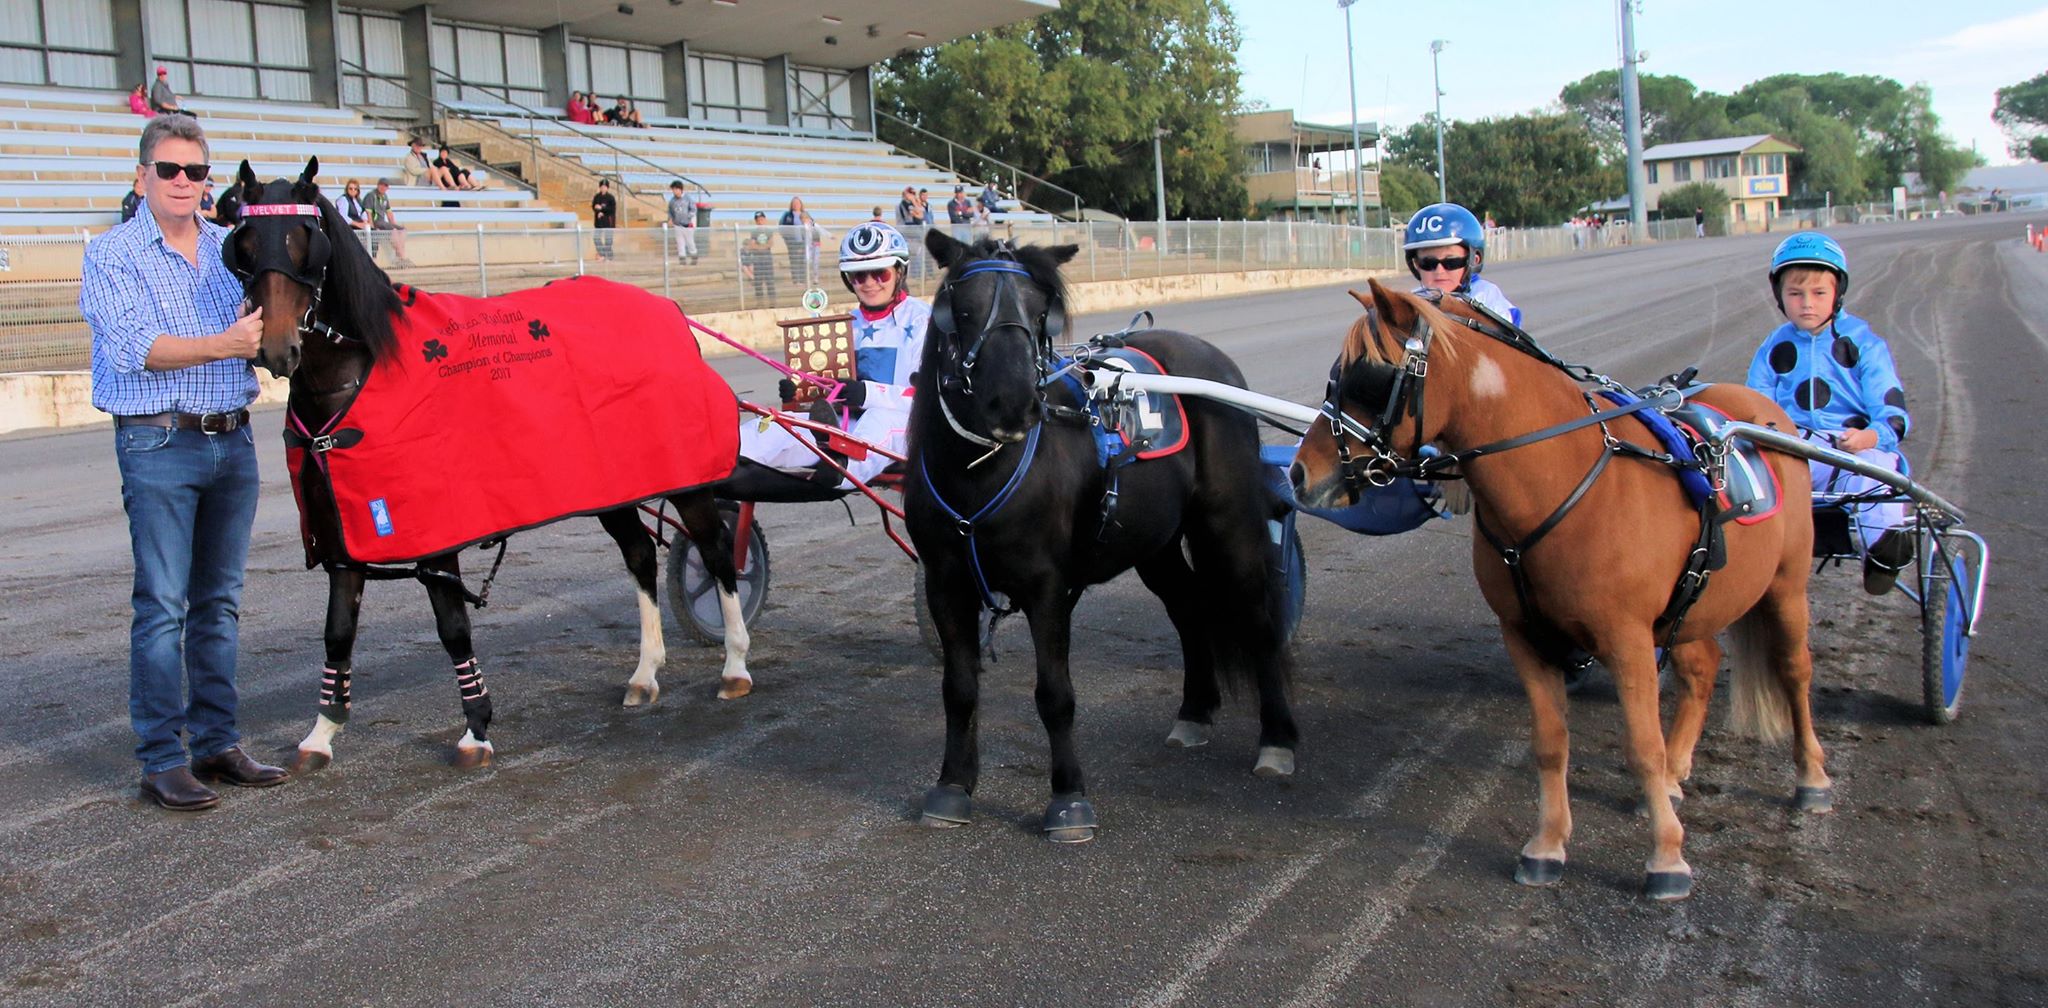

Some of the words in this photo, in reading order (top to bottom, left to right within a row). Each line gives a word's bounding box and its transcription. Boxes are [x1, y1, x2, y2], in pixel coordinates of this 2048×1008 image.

[251, 205, 292, 215] VELVET
[1415, 215, 1443, 234] JC
[468, 330, 517, 350] Memorial
[438, 355, 490, 378] Champion
[492, 354, 501, 364] of
[502, 348, 553, 363] Champions
[490, 367, 512, 381] 2017
